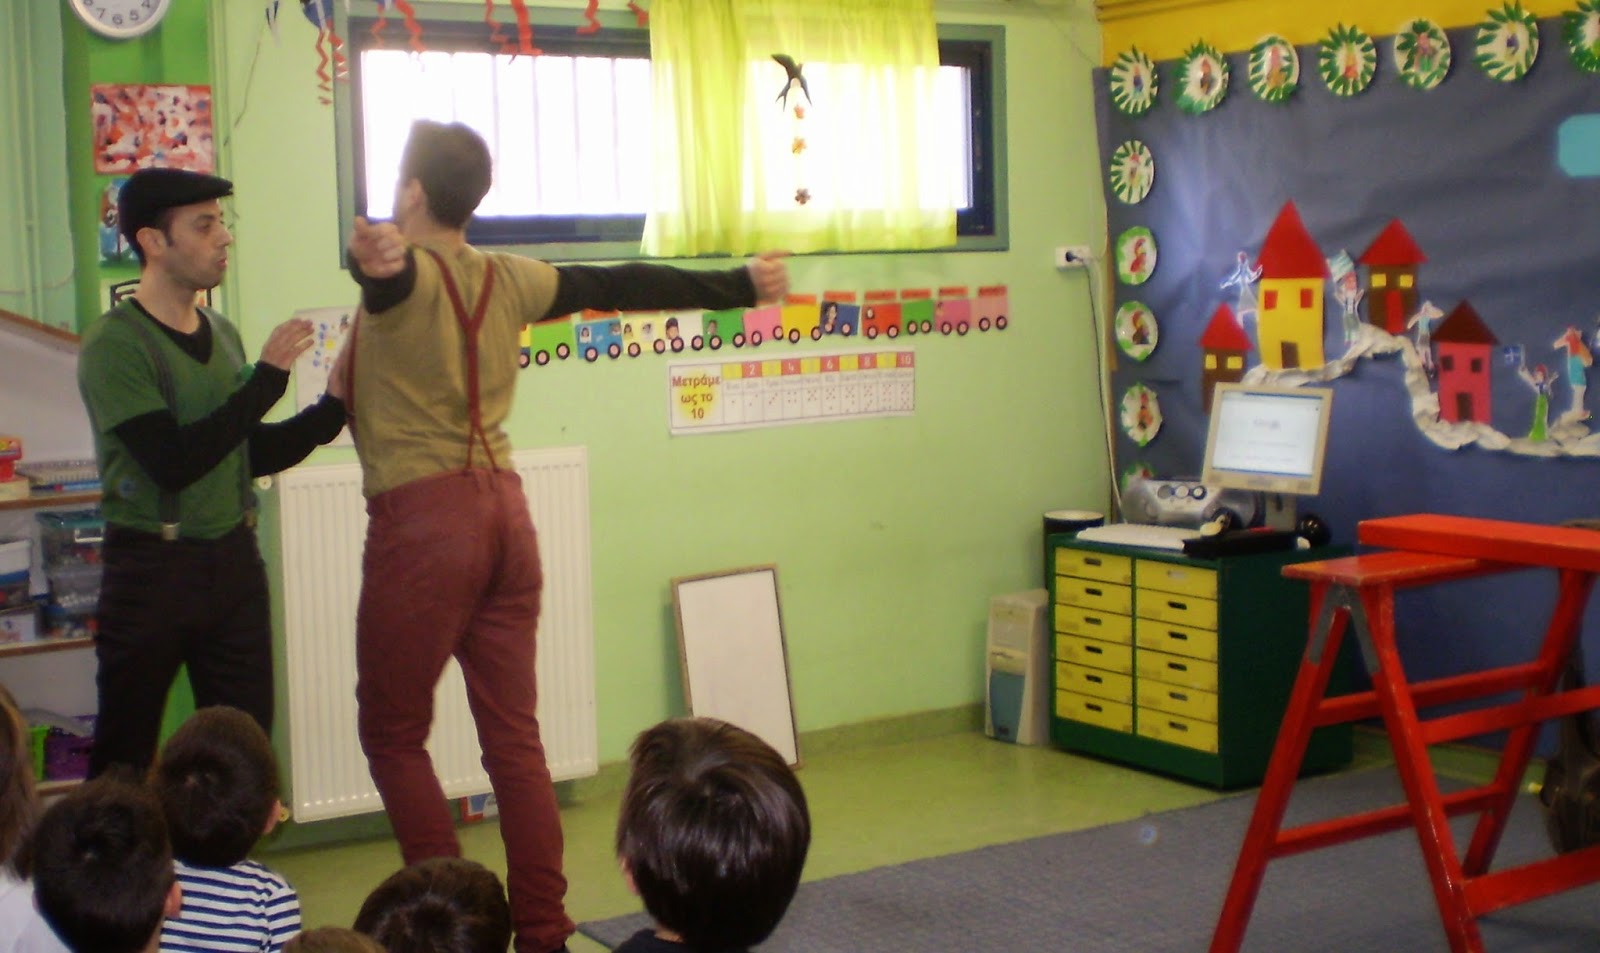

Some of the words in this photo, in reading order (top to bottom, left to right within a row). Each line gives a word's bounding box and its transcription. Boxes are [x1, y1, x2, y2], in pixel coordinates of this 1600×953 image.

[141, 0, 150, 8] 4
[96, 8, 105, 19] 7
[112, 14, 123, 25] 6
[129, 9, 139, 21] 5
[749, 363, 756, 376] 2
[788, 362, 795, 372] 4
[826, 359, 834, 369] 6
[864, 355, 871, 367] 8
[900, 354, 912, 366] 10
[672, 374, 720, 388] Μετράμε
[681, 393, 698, 405] ως
[701, 393, 713, 402] το
[691, 407, 704, 419] 10
